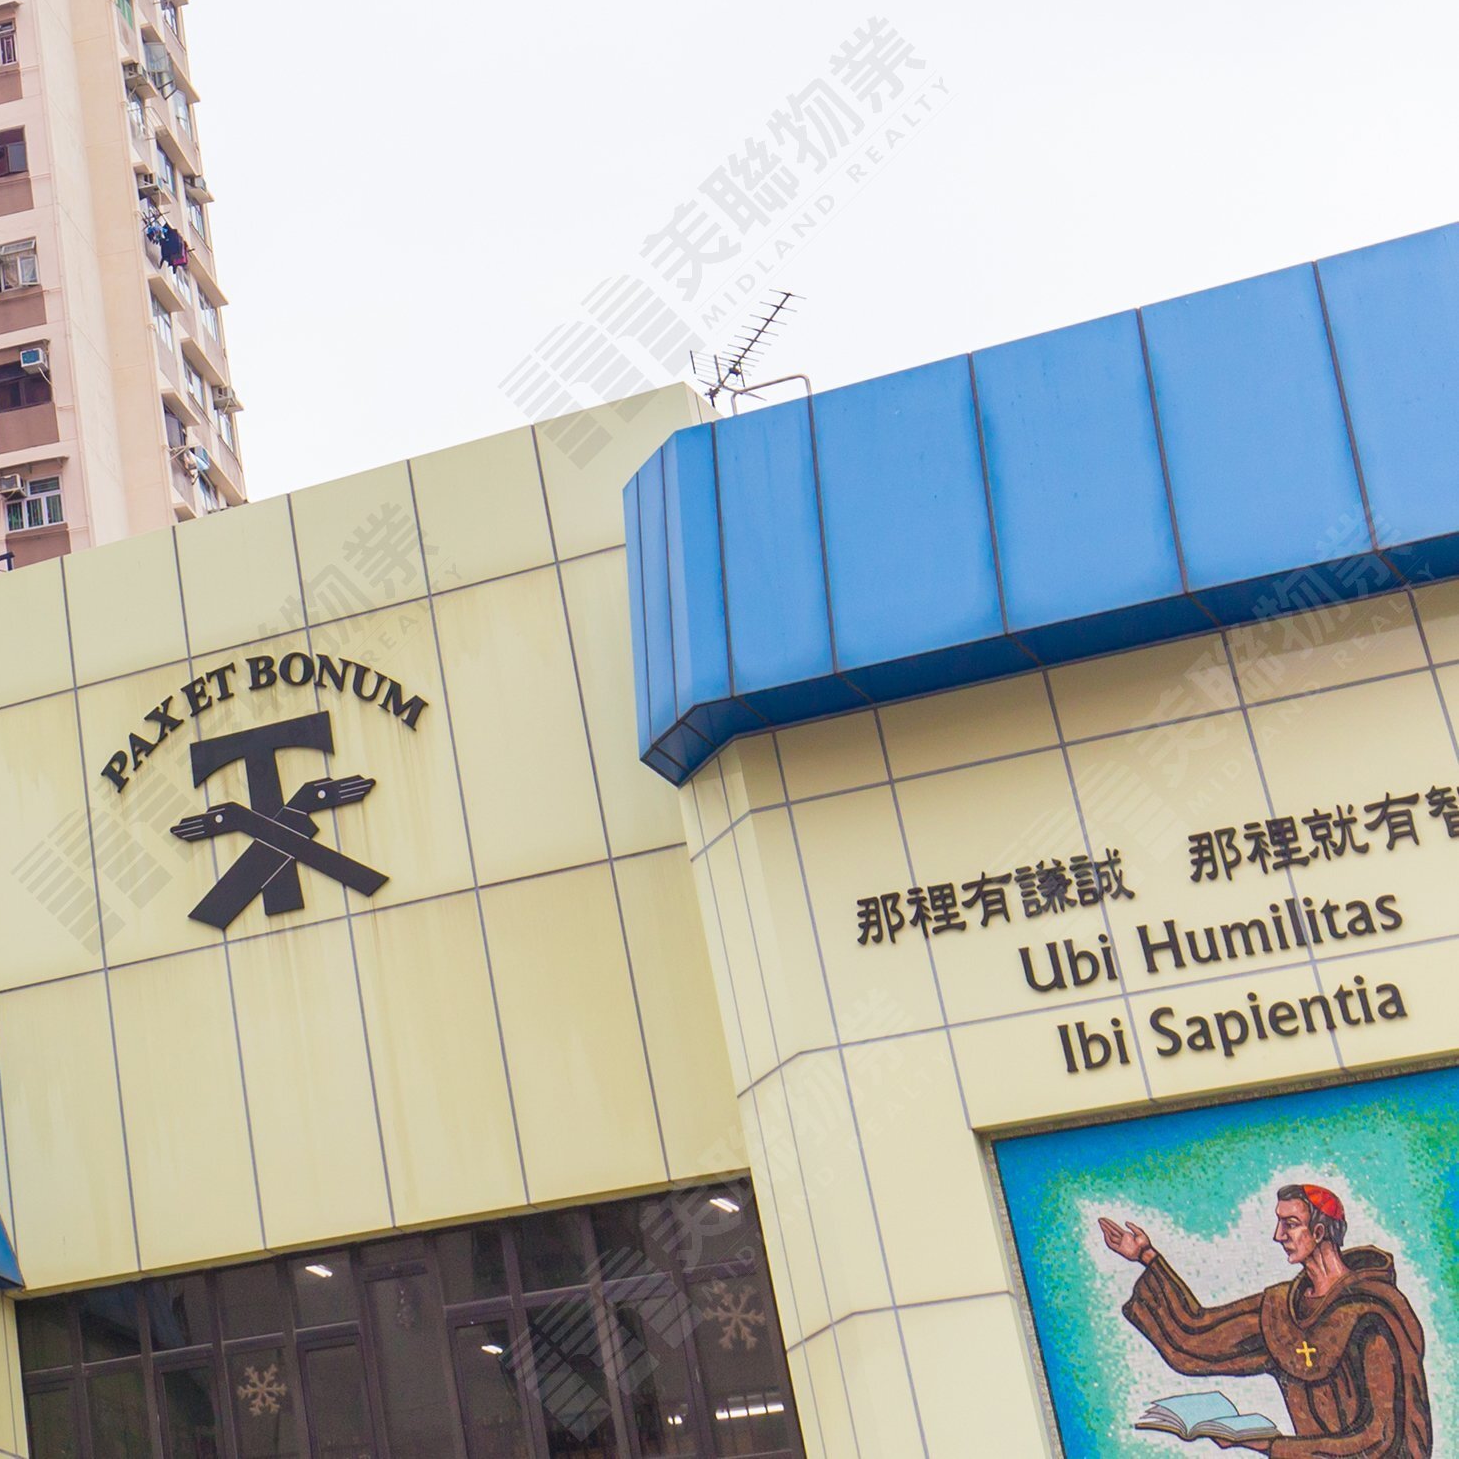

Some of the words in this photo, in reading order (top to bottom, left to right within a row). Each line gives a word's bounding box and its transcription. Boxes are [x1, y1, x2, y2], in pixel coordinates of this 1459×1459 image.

[101, 696, 184, 793] PAX
[181, 662, 237, 717] ET
[245, 652, 429, 731] BONUM
[856, 847, 1135, 945] 那裡有謙誠
[1018, 933, 1118, 992] Ubi
[1136, 894, 1403, 973] Humilitas
[1056, 1017, 1130, 1073] Ibi
[1149, 975, 1408, 1057] Sapientia
